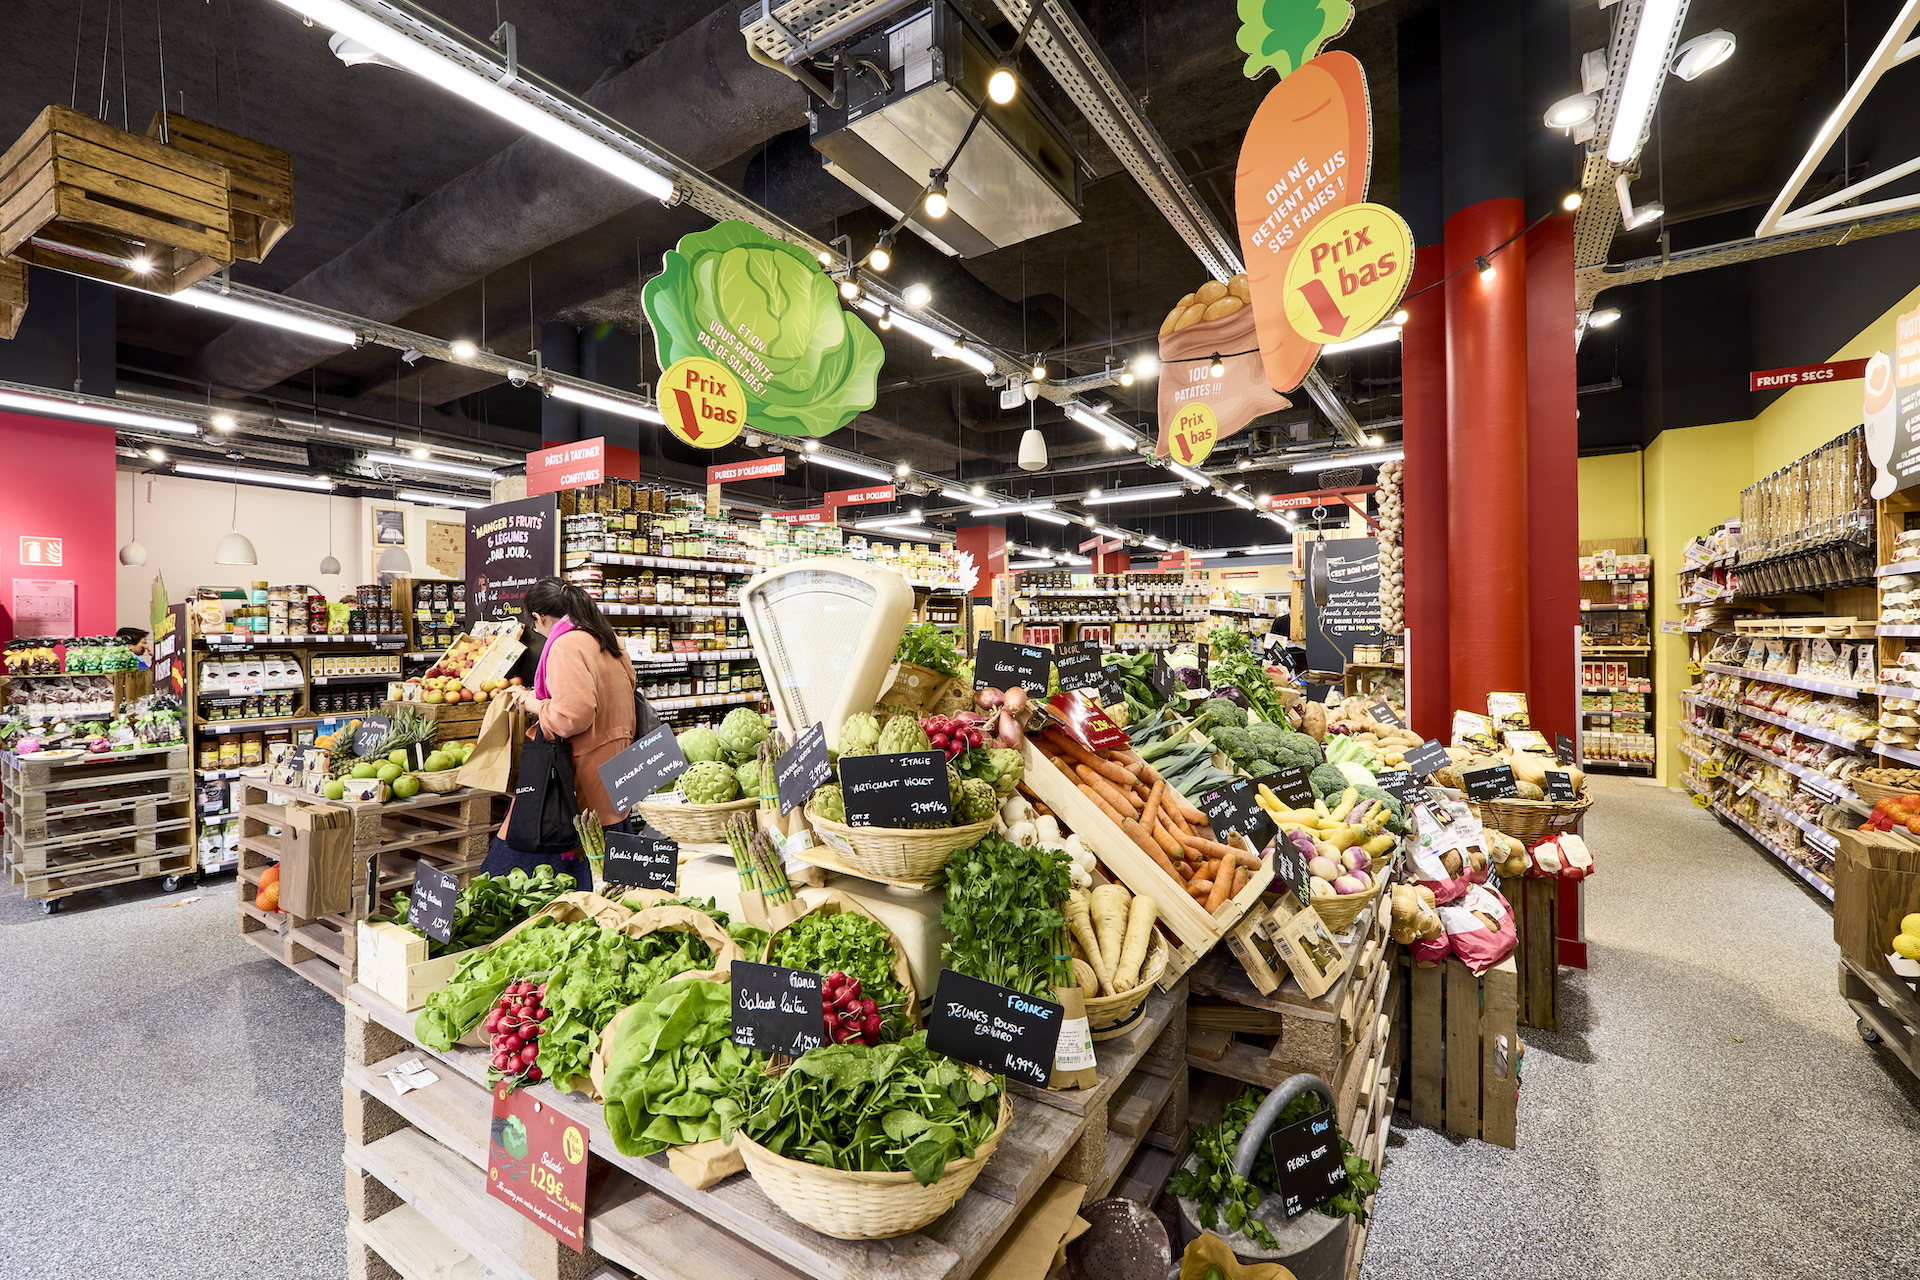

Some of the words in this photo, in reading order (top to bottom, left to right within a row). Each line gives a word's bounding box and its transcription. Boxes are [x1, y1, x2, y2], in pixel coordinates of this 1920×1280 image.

[1266, 178, 1288, 205] ON
[1287, 157, 1309, 184] NE
[1251, 185, 1304, 247] RETIENT
[1305, 150, 1346, 192] PLUS
[1268, 224, 1294, 254] SES
[1292, 183, 1336, 229] FANES
[1310, 225, 1374, 275] Prix
[1338, 251, 1397, 297] bas
[738, 322, 753, 339] ET
[750, 335, 766, 353] ON
[697, 330, 717, 352] PAS
[715, 346, 729, 361] DE
[727, 354, 763, 393] SALADES
[709, 319, 736, 347] VOUS
[735, 339, 774, 383] RACONTE
[686, 369, 727, 398] Prix
[1189, 365, 1209, 383] 100
[1757, 373, 1798, 387] FRUITS
[1801, 369, 1834, 382] SECS
[1175, 383, 1210, 403] PATATES
[702, 397, 737, 425] bas
[1180, 413, 1204, 431] Prix
[1190, 428, 1212, 445] bas
[545, 451, 564, 467] PÂTES
[570, 445, 600, 461] TARTINER
[560, 469, 600, 486] CONFITURES
[714, 468, 737, 480] PURÉES
[737, 463, 783, 478] D'OLÉAGINEUX
[1271, 497, 1312, 508] BISCOTTES
[476, 516, 508, 540] MANGER
[508, 516, 515, 527] 5
[515, 515, 543, 531] FRUITS
[494, 530, 529, 546] LÉGUMES
[490, 547, 505, 562] PAR
[789, 971, 817, 989] France
[739, 988, 777, 1011] Salade
[1007, 995, 1054, 1021] FRANCE
[568, 1131, 580, 1145] Prix
[530, 1163, 564, 1202] 1,29€
